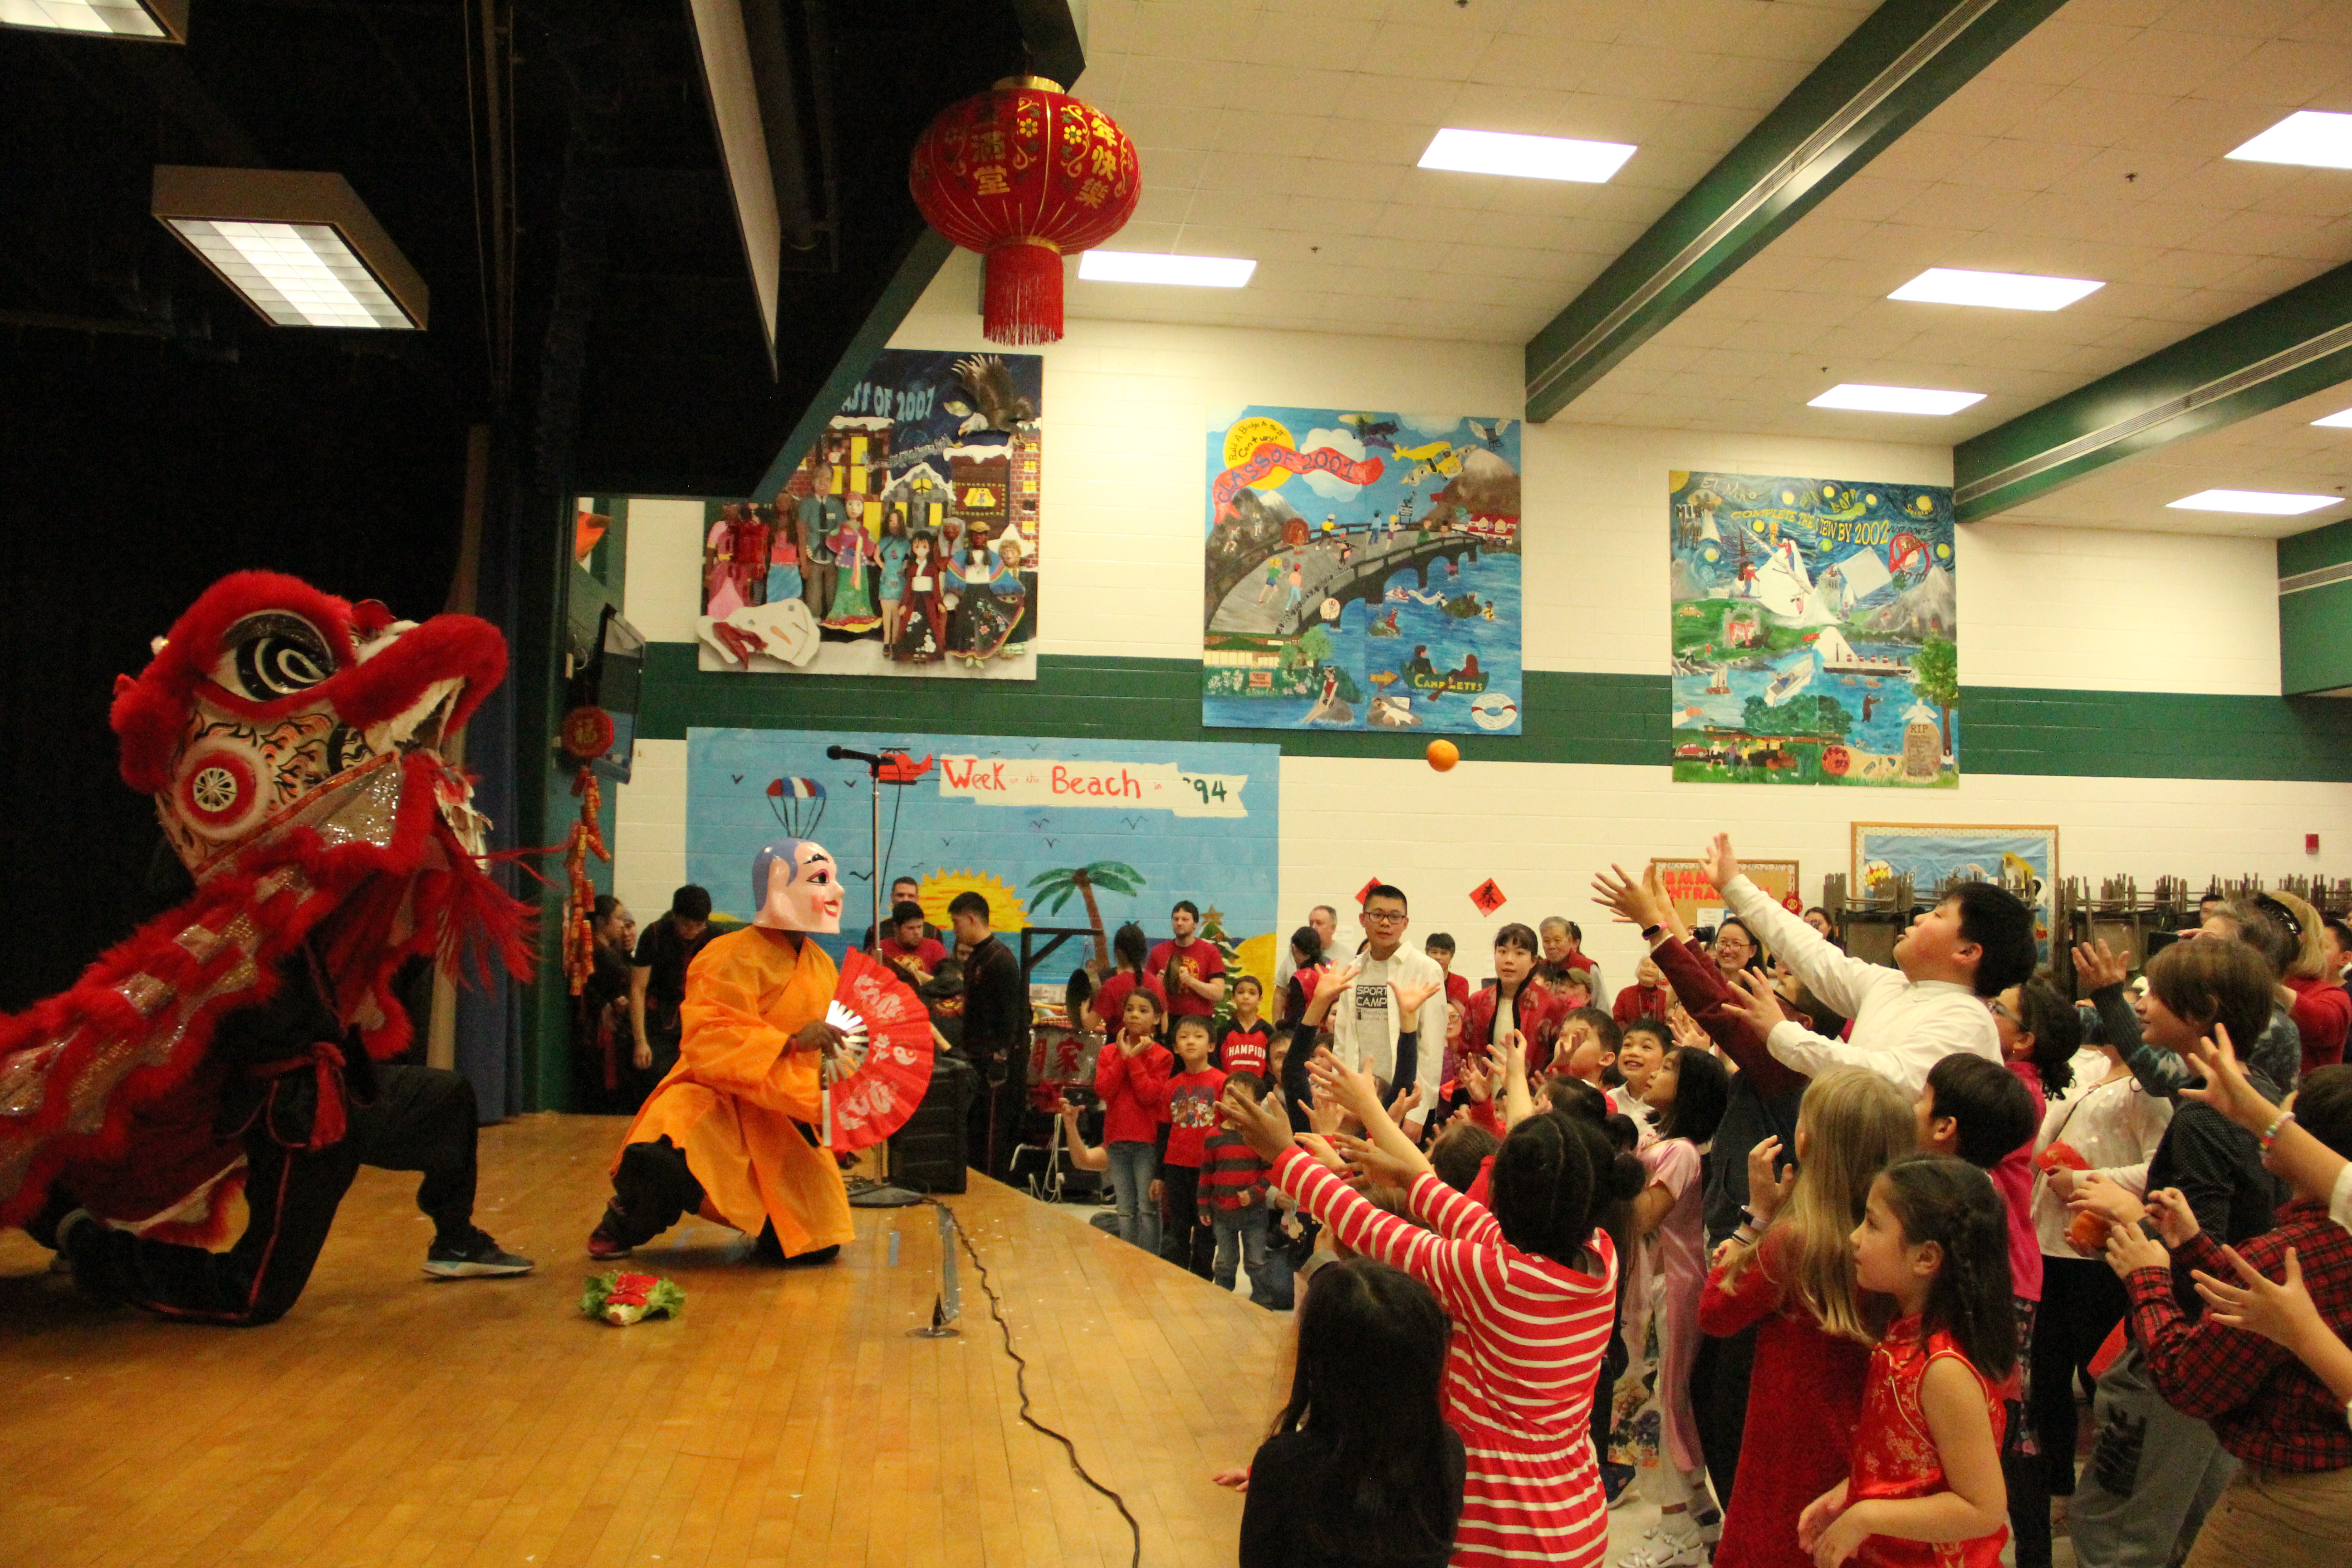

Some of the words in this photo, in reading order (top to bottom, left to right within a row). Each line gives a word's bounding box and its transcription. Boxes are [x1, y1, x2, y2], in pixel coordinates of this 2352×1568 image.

[874, 385, 893, 418] OF
[896, 385, 936, 422] 2007
[1239, 421, 1260, 435] Bridge
[1217, 453, 1271, 503] CLASS
[1271, 448, 1297, 466] OF
[1301, 451, 1356, 480] 2001
[1731, 509, 1796, 522] COMPLETE
[1798, 512, 1813, 529] THE
[1837, 522, 1852, 543] BY
[1855, 520, 1890, 545] 2002
[1910, 724, 1928, 733] RIP
[940, 759, 1007, 791] Week
[1051, 765, 1142, 800] Beach
[1356, 996, 1387, 1007] CAMP
[1226, 1044, 1266, 1059] HAMPION
